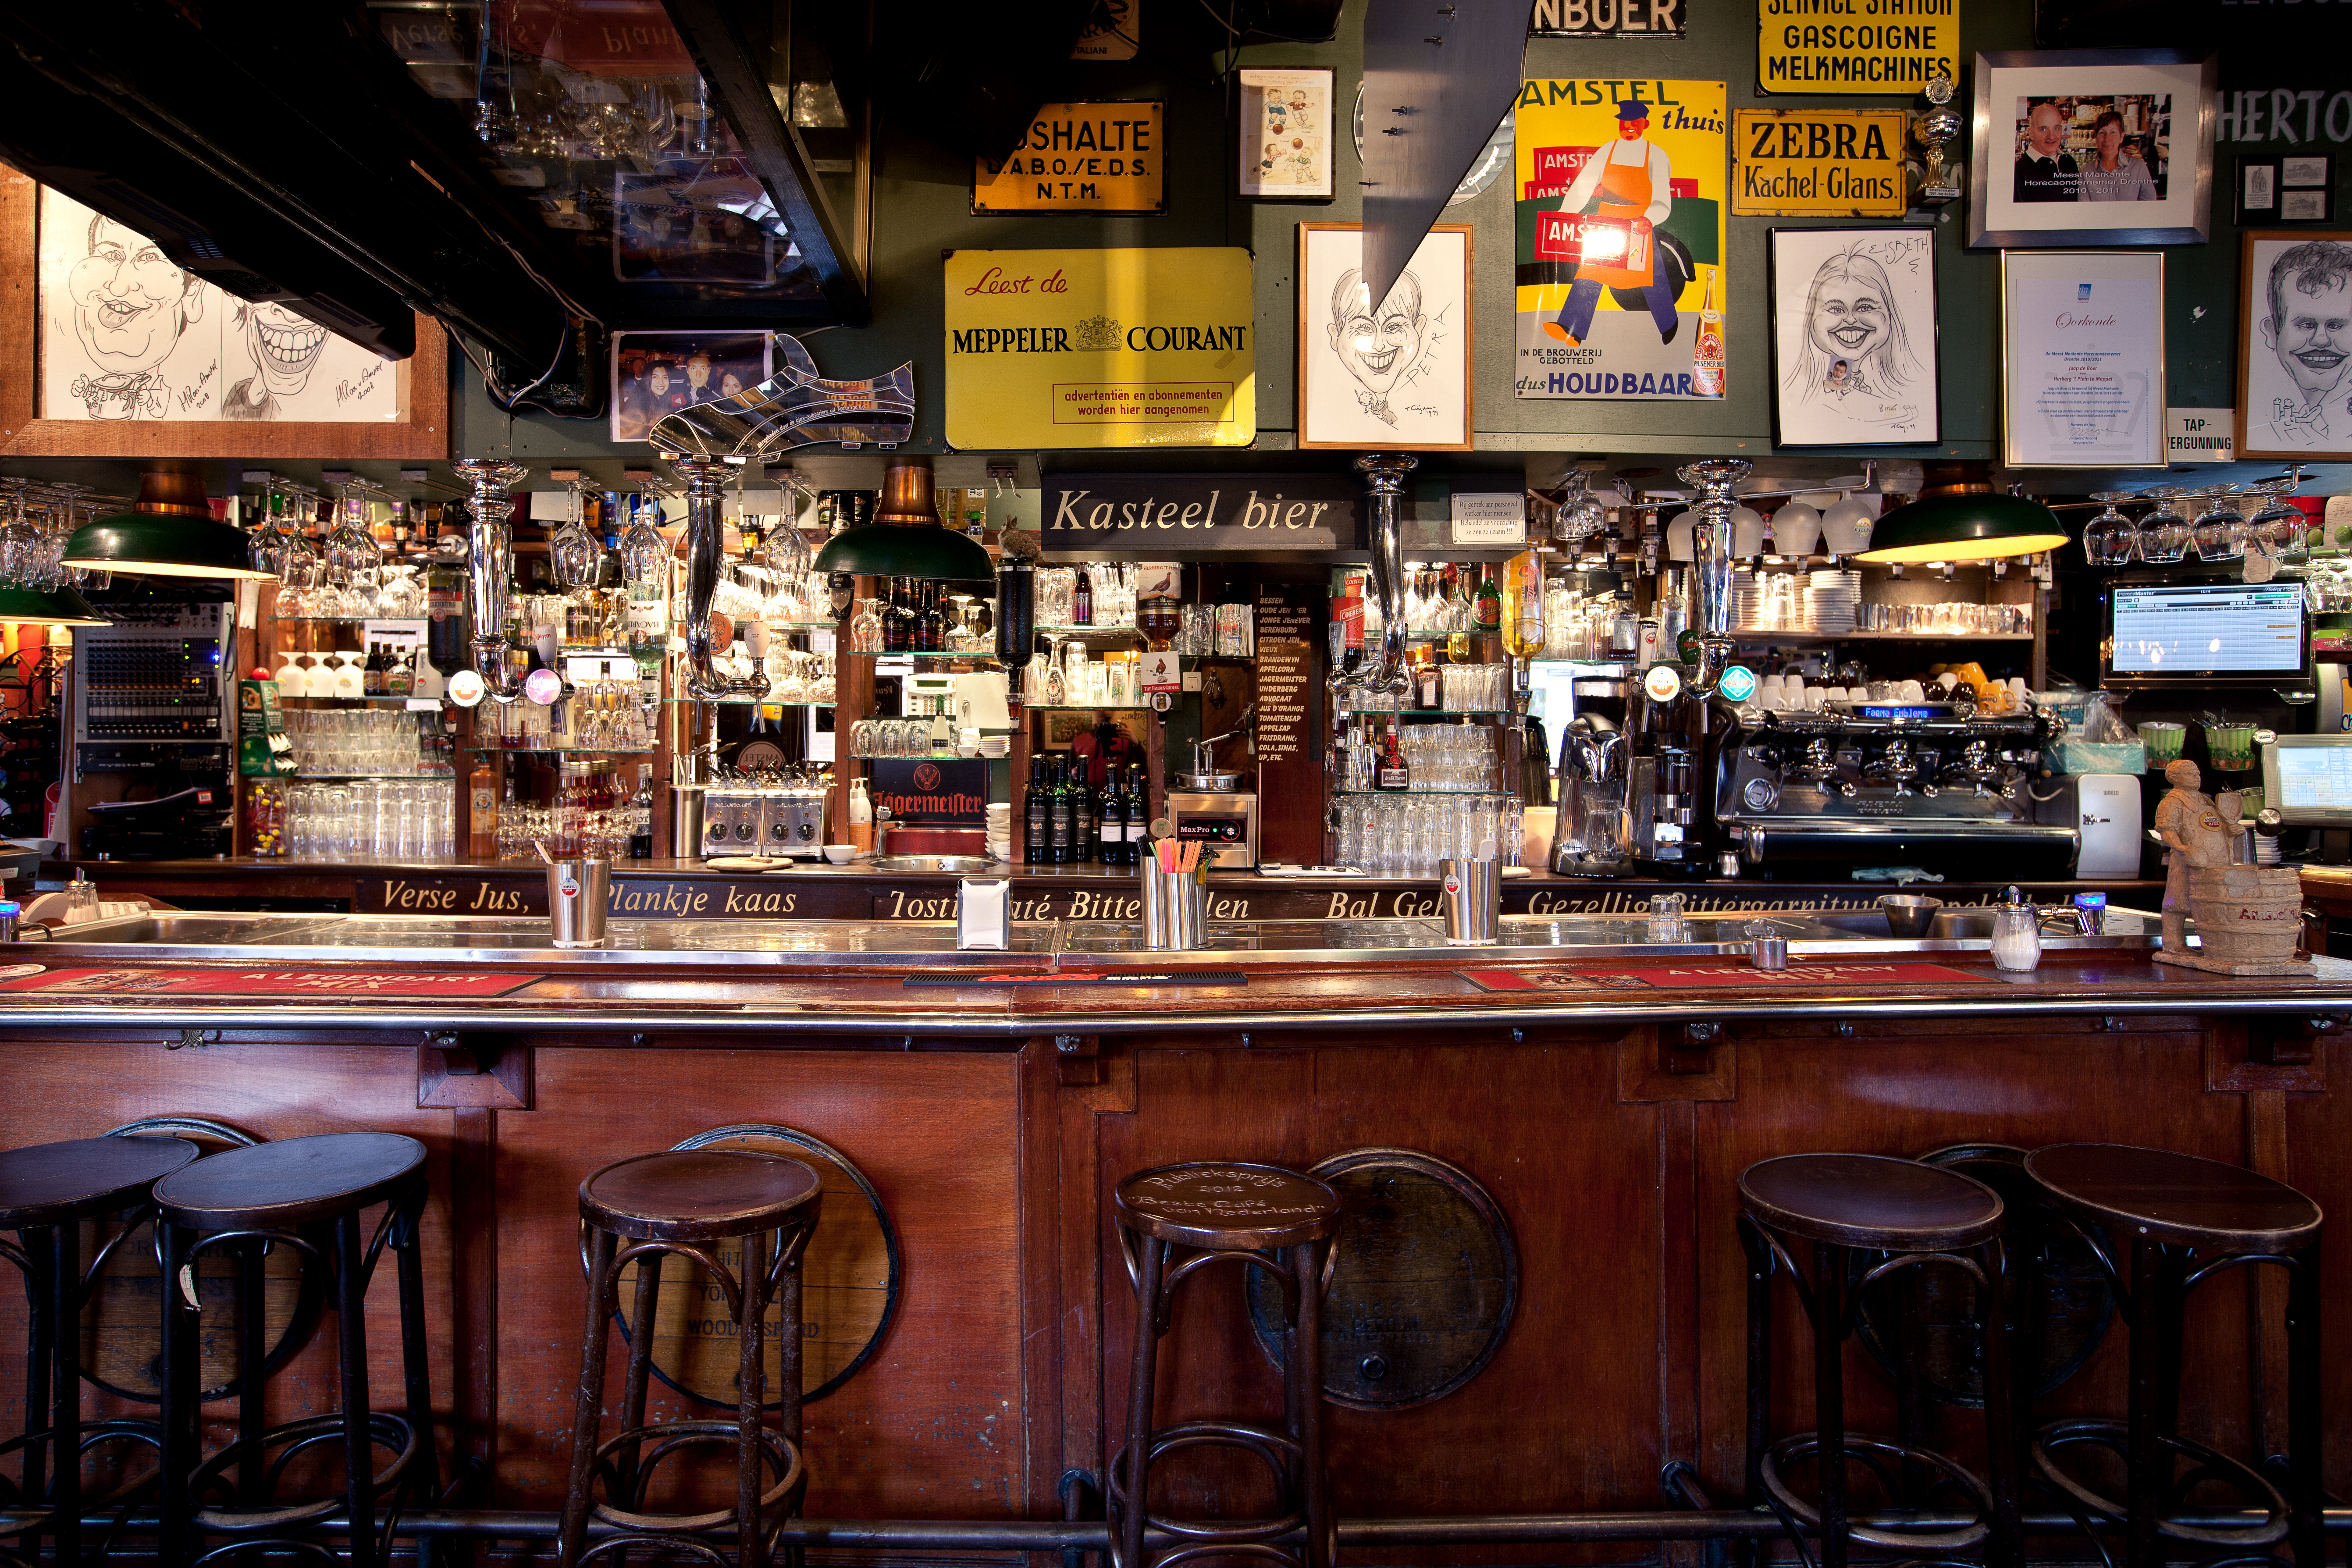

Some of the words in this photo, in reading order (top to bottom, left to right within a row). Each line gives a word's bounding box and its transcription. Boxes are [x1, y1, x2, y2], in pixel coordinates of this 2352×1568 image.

[1768, 0, 1856, 15] SERVICE
[1867, 0, 1951, 16] STATION
[1784, 25, 1936, 50] GASCOIGNE
[1769, 56, 1951, 82] MELKMACHINES
[1519, 81, 1679, 109] AMSTEL
[1663, 106, 1724, 134] thuis
[1751, 123, 1890, 160] ZEBRA
[1037, 182, 1101, 200] N.T.M.
[964, 267, 1034, 296] Leest
[1040, 268, 1068, 293] de
[2056, 312, 2116, 329] Oorkonde
[953, 327, 1073, 354] MEPPELER
[1127, 323, 1247, 352] COURANT
[1064, 389, 1130, 401] advertentiën
[1133, 392, 1146, 401] en
[1148, 388, 1223, 401] abonnementen
[1516, 376, 1546, 390] dus
[1548, 373, 1693, 395] HOUDBAAR
[1078, 403, 1117, 416] worden
[1120, 403, 1141, 415] hier
[1144, 404, 1210, 417] aangenomen
[1051, 491, 1220, 530] Kasteel
[1243, 491, 1328, 530] bier
[1495, 501, 1517, 509] personeel
[385, 880, 457, 910] Verse
[471, 882, 529, 913] Jus,
[725, 885, 797, 913] kaas
[1327, 892, 1381, 919] Bal
[274, 973, 490, 982] LEGENDARY
[1142, 1169, 1286, 1191] Publieksprijs
